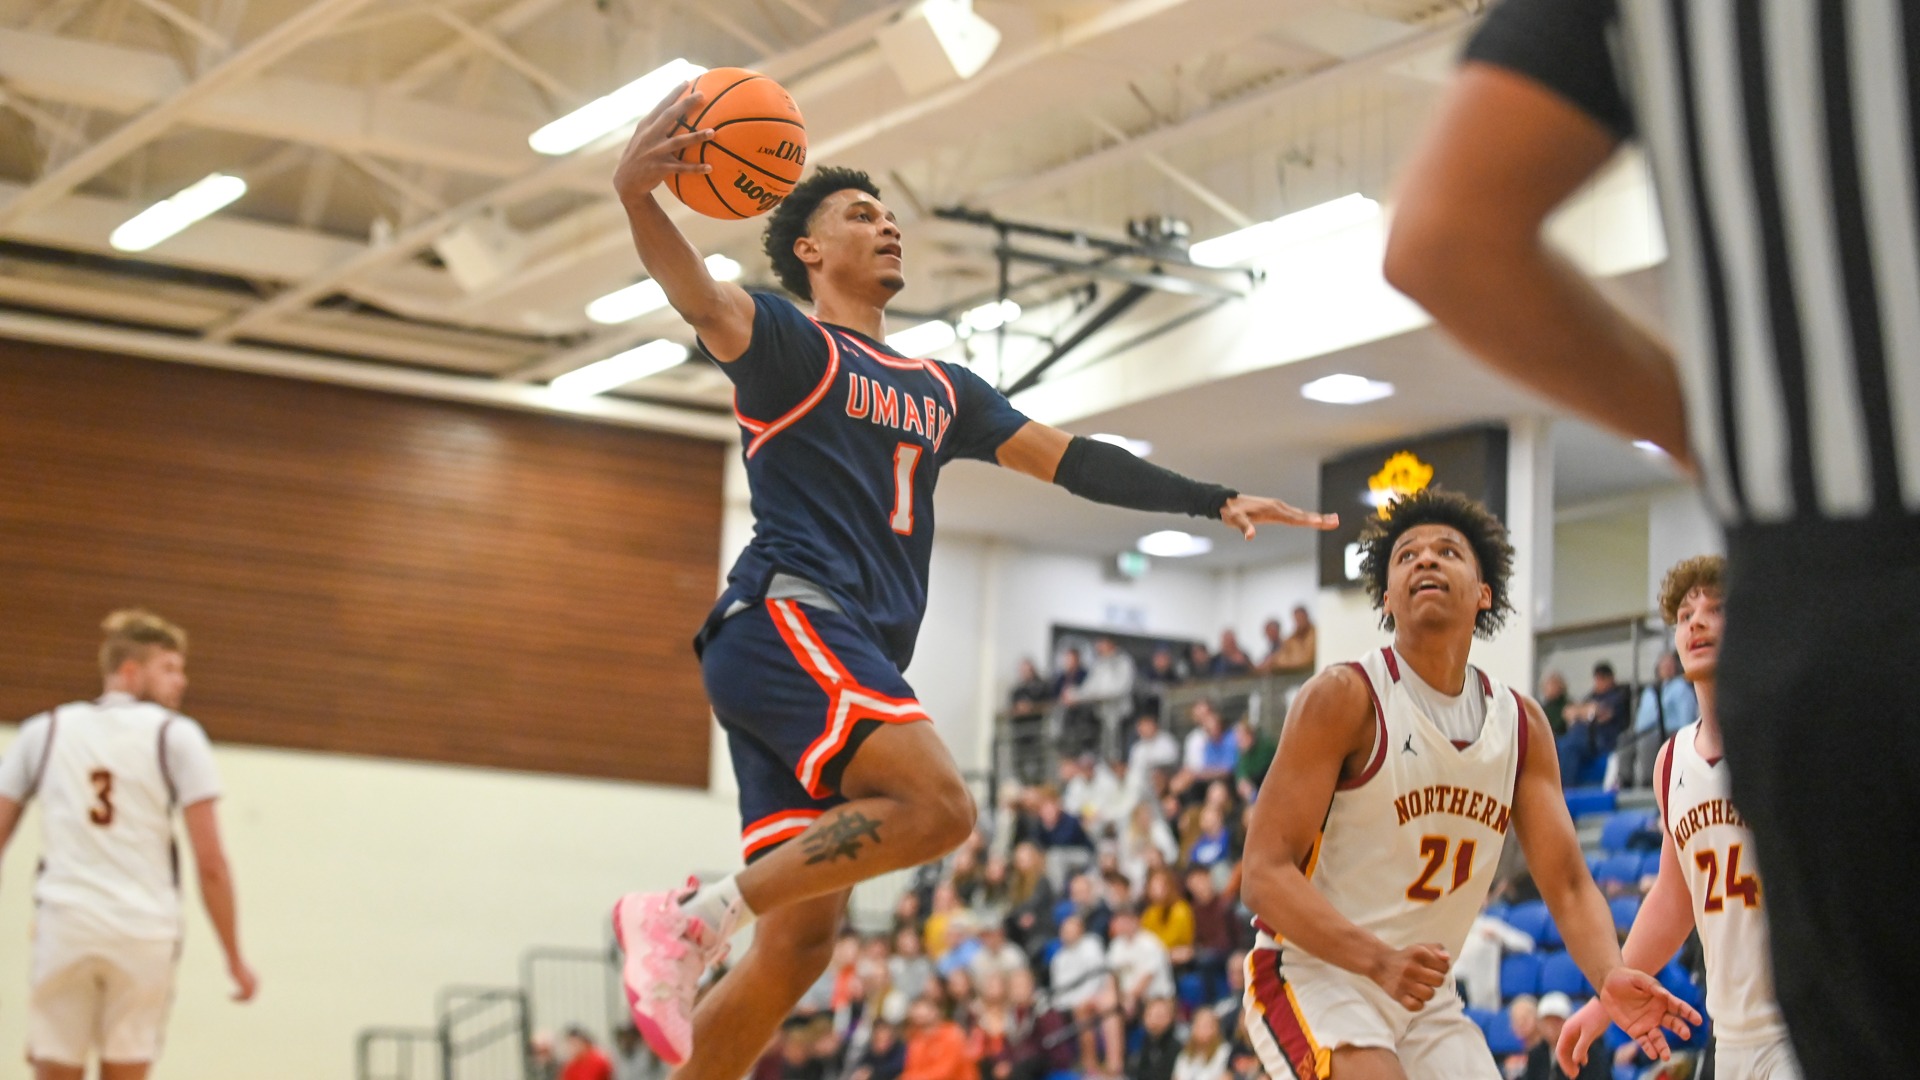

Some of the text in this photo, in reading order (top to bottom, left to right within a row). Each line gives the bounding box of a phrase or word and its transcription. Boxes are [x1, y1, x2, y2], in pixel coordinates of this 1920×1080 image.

[733, 172, 786, 211] lson
[845, 372, 951, 454] UMARY
[889, 441, 923, 536] 1
[88, 768, 114, 828] 3
[1394, 784, 1512, 836] NORTHERN
[1674, 799, 1747, 852] NORTHE
[1405, 834, 1477, 905] 21
[1694, 843, 1763, 914] 24
